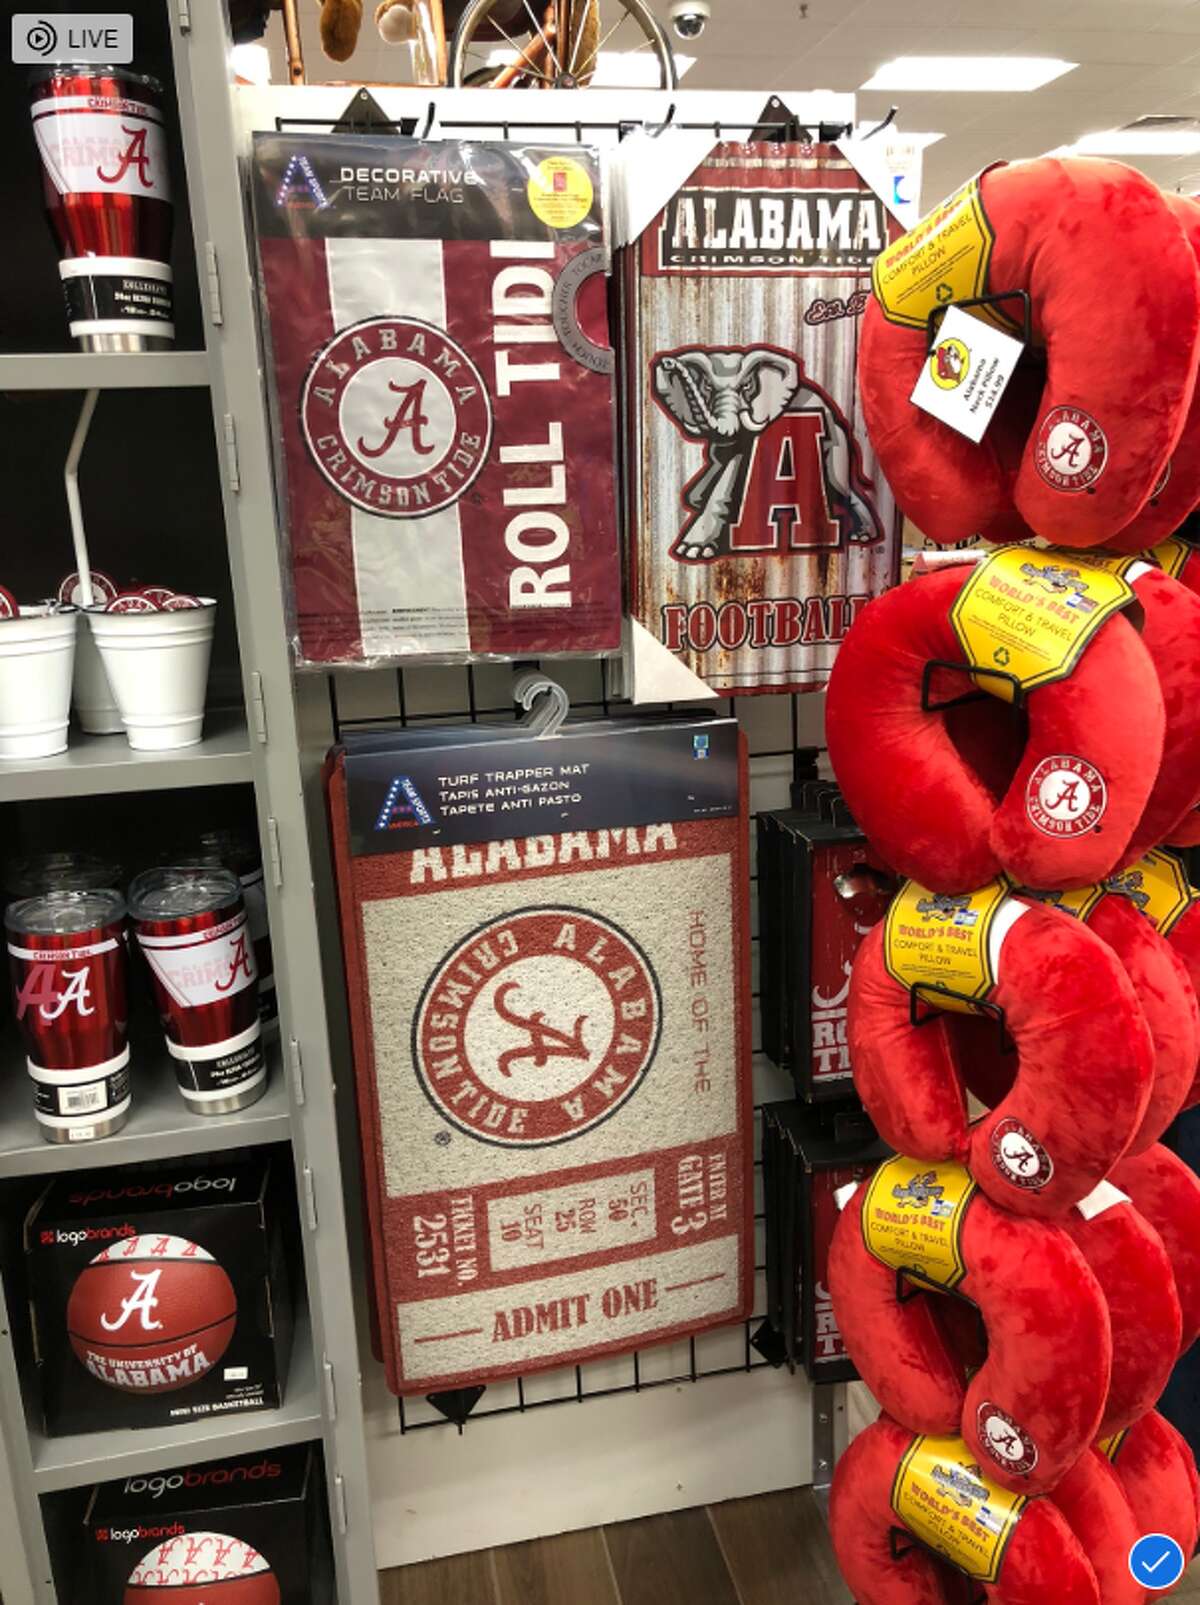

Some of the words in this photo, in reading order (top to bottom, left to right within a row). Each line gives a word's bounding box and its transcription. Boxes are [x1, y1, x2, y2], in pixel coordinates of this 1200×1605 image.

[96, 124, 154, 188] A
[340, 166, 479, 186] DECORATIVE
[342, 186, 400, 202] TEAM
[412, 187, 465, 204] FLAG
[671, 197, 882, 250] ALABAMA
[669, 255, 805, 265] CRIMSON
[911, 246, 946, 275] PILLOW
[313, 328, 477, 406] ALABAMA
[963, 357, 987, 401] Alabama
[969, 389, 985, 413] Neck
[982, 357, 1000, 388] Pillow
[357, 379, 435, 459] A
[317, 434, 430, 506] CRIMSON
[431, 431, 481, 492] TIDE
[1051, 433, 1084, 468] A
[730, 410, 841, 551] A
[500, 422, 572, 609] ROLL
[974, 588, 1026, 616] COMFORT
[1037, 617, 1072, 642] TRAVEL
[989, 575, 1045, 607] WORLD'S
[1047, 600, 1080, 624] BEST
[998, 612, 1036, 637] PILLOW
[438, 773, 479, 787] TURF
[484, 766, 554, 782] TRAPPER
[560, 762, 590, 776] MAT
[438, 788, 480, 803] TAPIS
[440, 802, 496, 817] TAPETE
[501, 799, 533, 811] ANTI
[539, 792, 583, 807] PASTO
[1045, 780, 1080, 812] A
[689, 909, 707, 989] HOME
[893, 939, 935, 950] COMFORT
[946, 944, 978, 957] TRAVEL
[898, 924, 945, 939] WORLD'S
[946, 926, 974, 942] BEST
[215, 932, 253, 991] A
[919, 953, 952, 965] PILLOW
[40, 966, 95, 1019] A
[428, 928, 520, 1080] CRIMSON
[493, 981, 593, 1079] A
[552, 923, 649, 1121] ALABAMA
[691, 996, 709, 1033] OF
[693, 1041, 712, 1095] THE
[450, 1078, 530, 1134] TIDE
[677, 1154, 707, 1211] GATE
[451, 1193, 477, 1253] TICKET
[523, 1203, 545, 1249] SEAT
[554, 1207, 577, 1234] 25
[578, 1197, 598, 1236] ROW
[608, 1197, 630, 1224] 50
[671, 1211, 709, 1236] 3
[920, 1215, 946, 1232] BEST
[56, 1221, 139, 1248] logobrands
[413, 1212, 452, 1278] 2531
[500, 1220, 523, 1243] 10
[455, 1256, 480, 1287] NO.
[100, 1268, 161, 1332] A
[491, 1293, 591, 1343] ADMIT
[601, 1278, 659, 1319] ONE
[85, 1351, 211, 1388] ALABAMA
[87, 1349, 109, 1368] THE
[108, 1350, 183, 1371] UNIVERSITY
[212, 1396, 264, 1411] BASKETBALL
[124, 1460, 282, 1500] logobrands
[110, 1521, 187, 1545] logobrands
